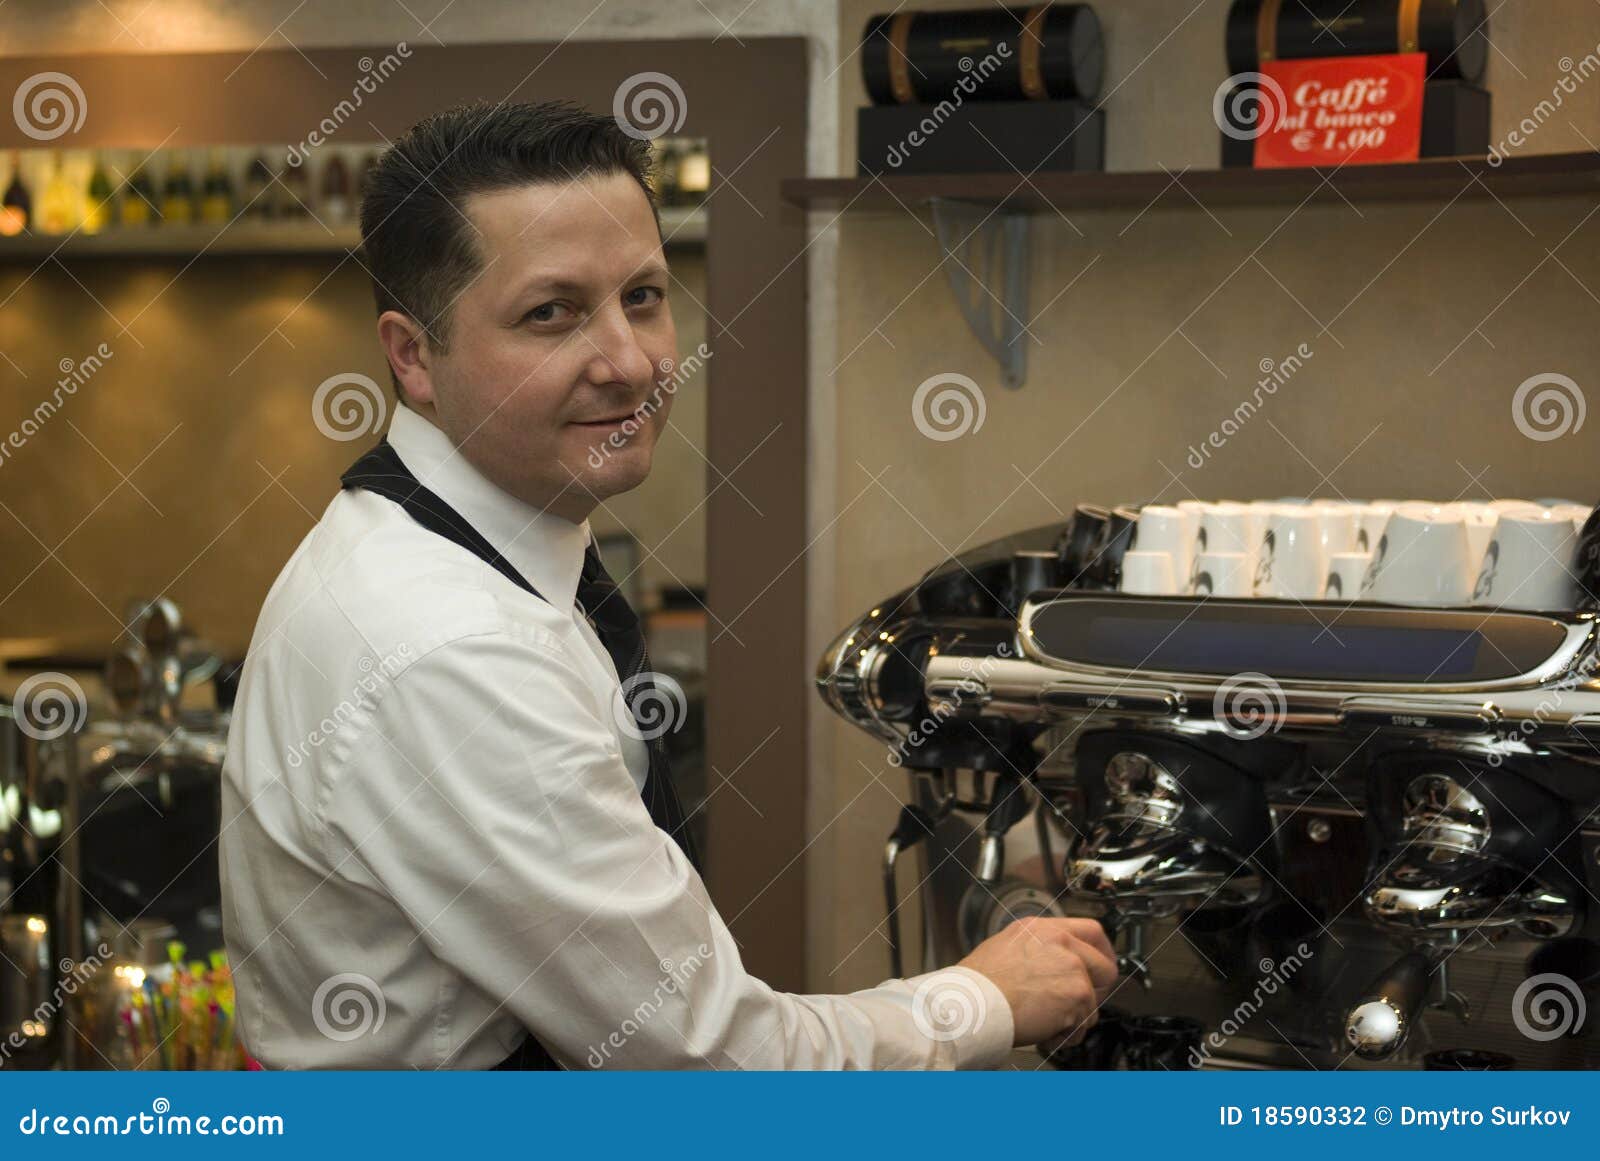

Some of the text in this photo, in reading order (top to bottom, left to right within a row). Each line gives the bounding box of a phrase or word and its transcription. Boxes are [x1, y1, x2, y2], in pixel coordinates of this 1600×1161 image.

[1294, 77, 1388, 112] Caffé
[1281, 107, 1396, 130] al banco
[1291, 130, 1316, 152] €
